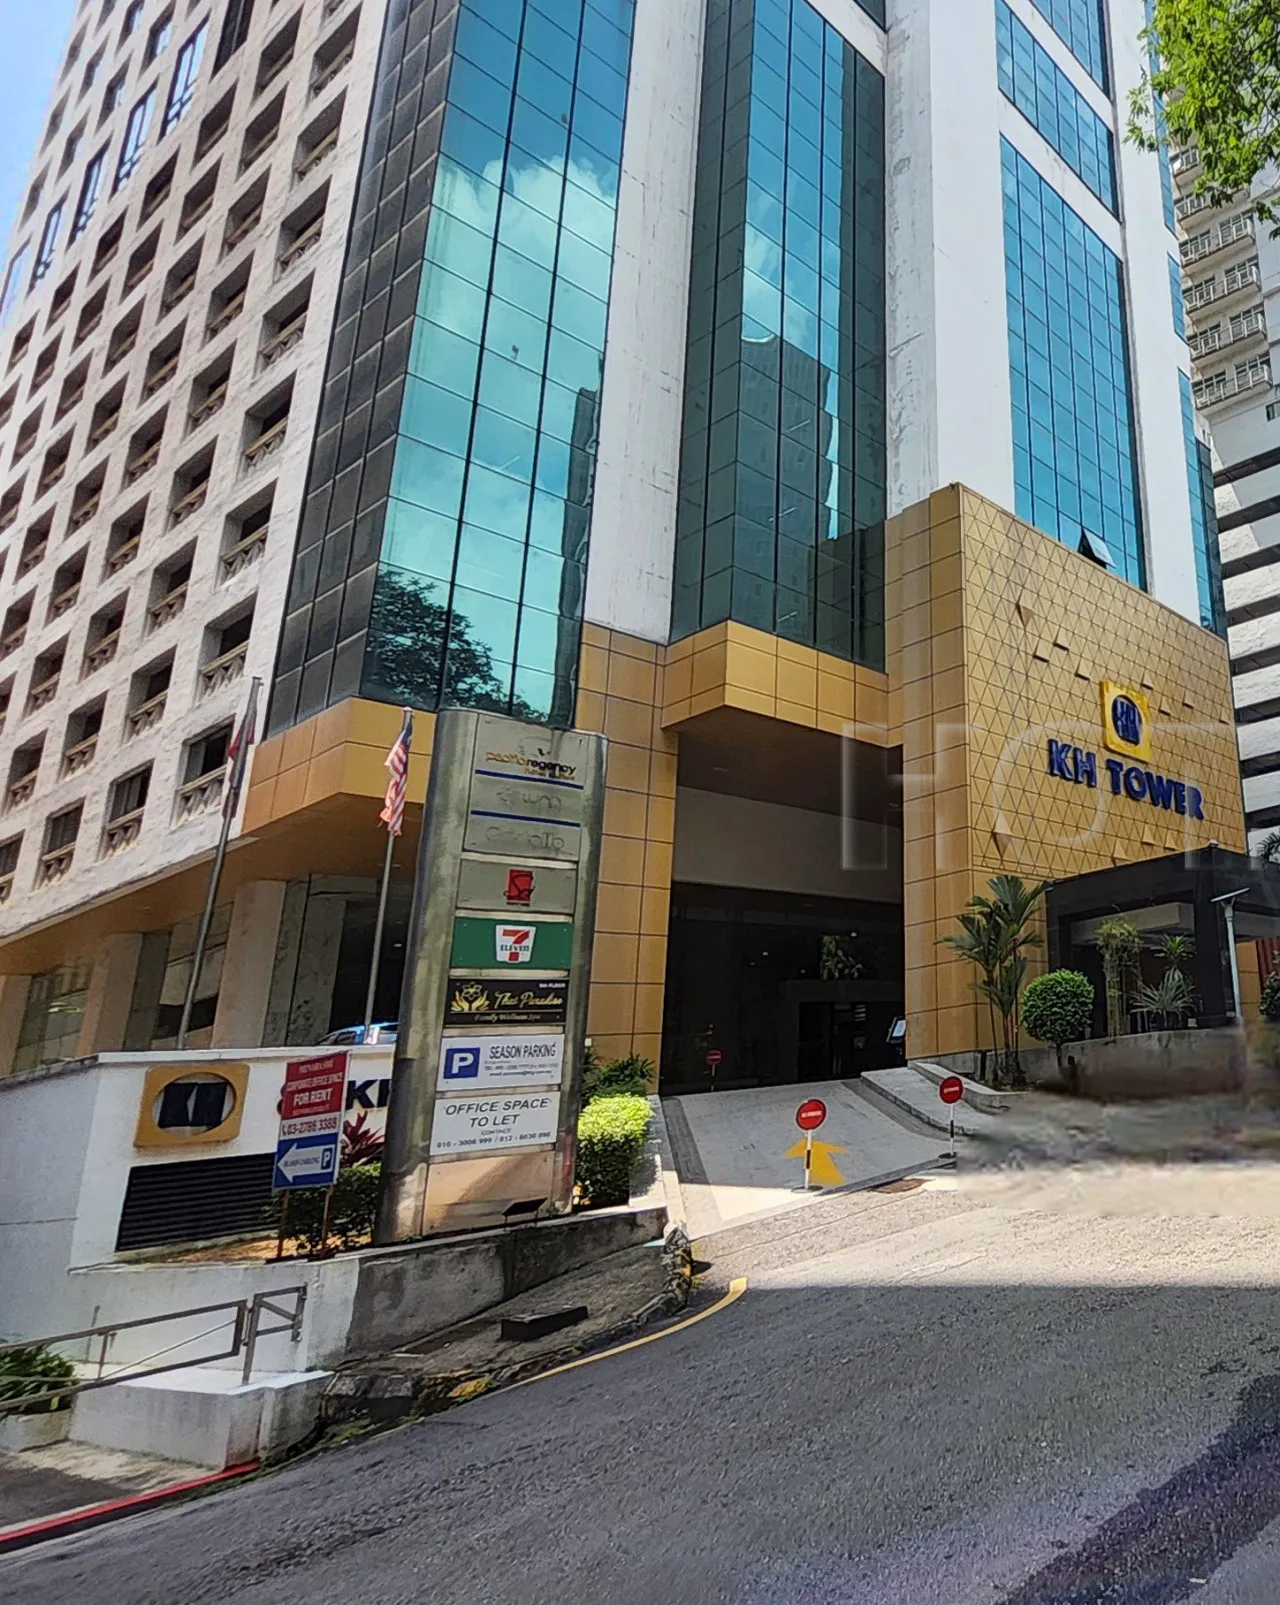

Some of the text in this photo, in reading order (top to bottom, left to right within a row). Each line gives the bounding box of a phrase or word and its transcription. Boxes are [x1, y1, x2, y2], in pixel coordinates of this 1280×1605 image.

[1048, 739, 1205, 820] KH TOWER
[502, 929, 530, 961] 7
[489, 1043, 556, 1060] SEASON PARKING
[451, 1052, 475, 1075] P
[293, 1087, 333, 1107] FOR RENT
[445, 1098, 549, 1115] OFFICE SPACE
[469, 1114, 520, 1128] TO LET
[323, 1151, 331, 1168] P
